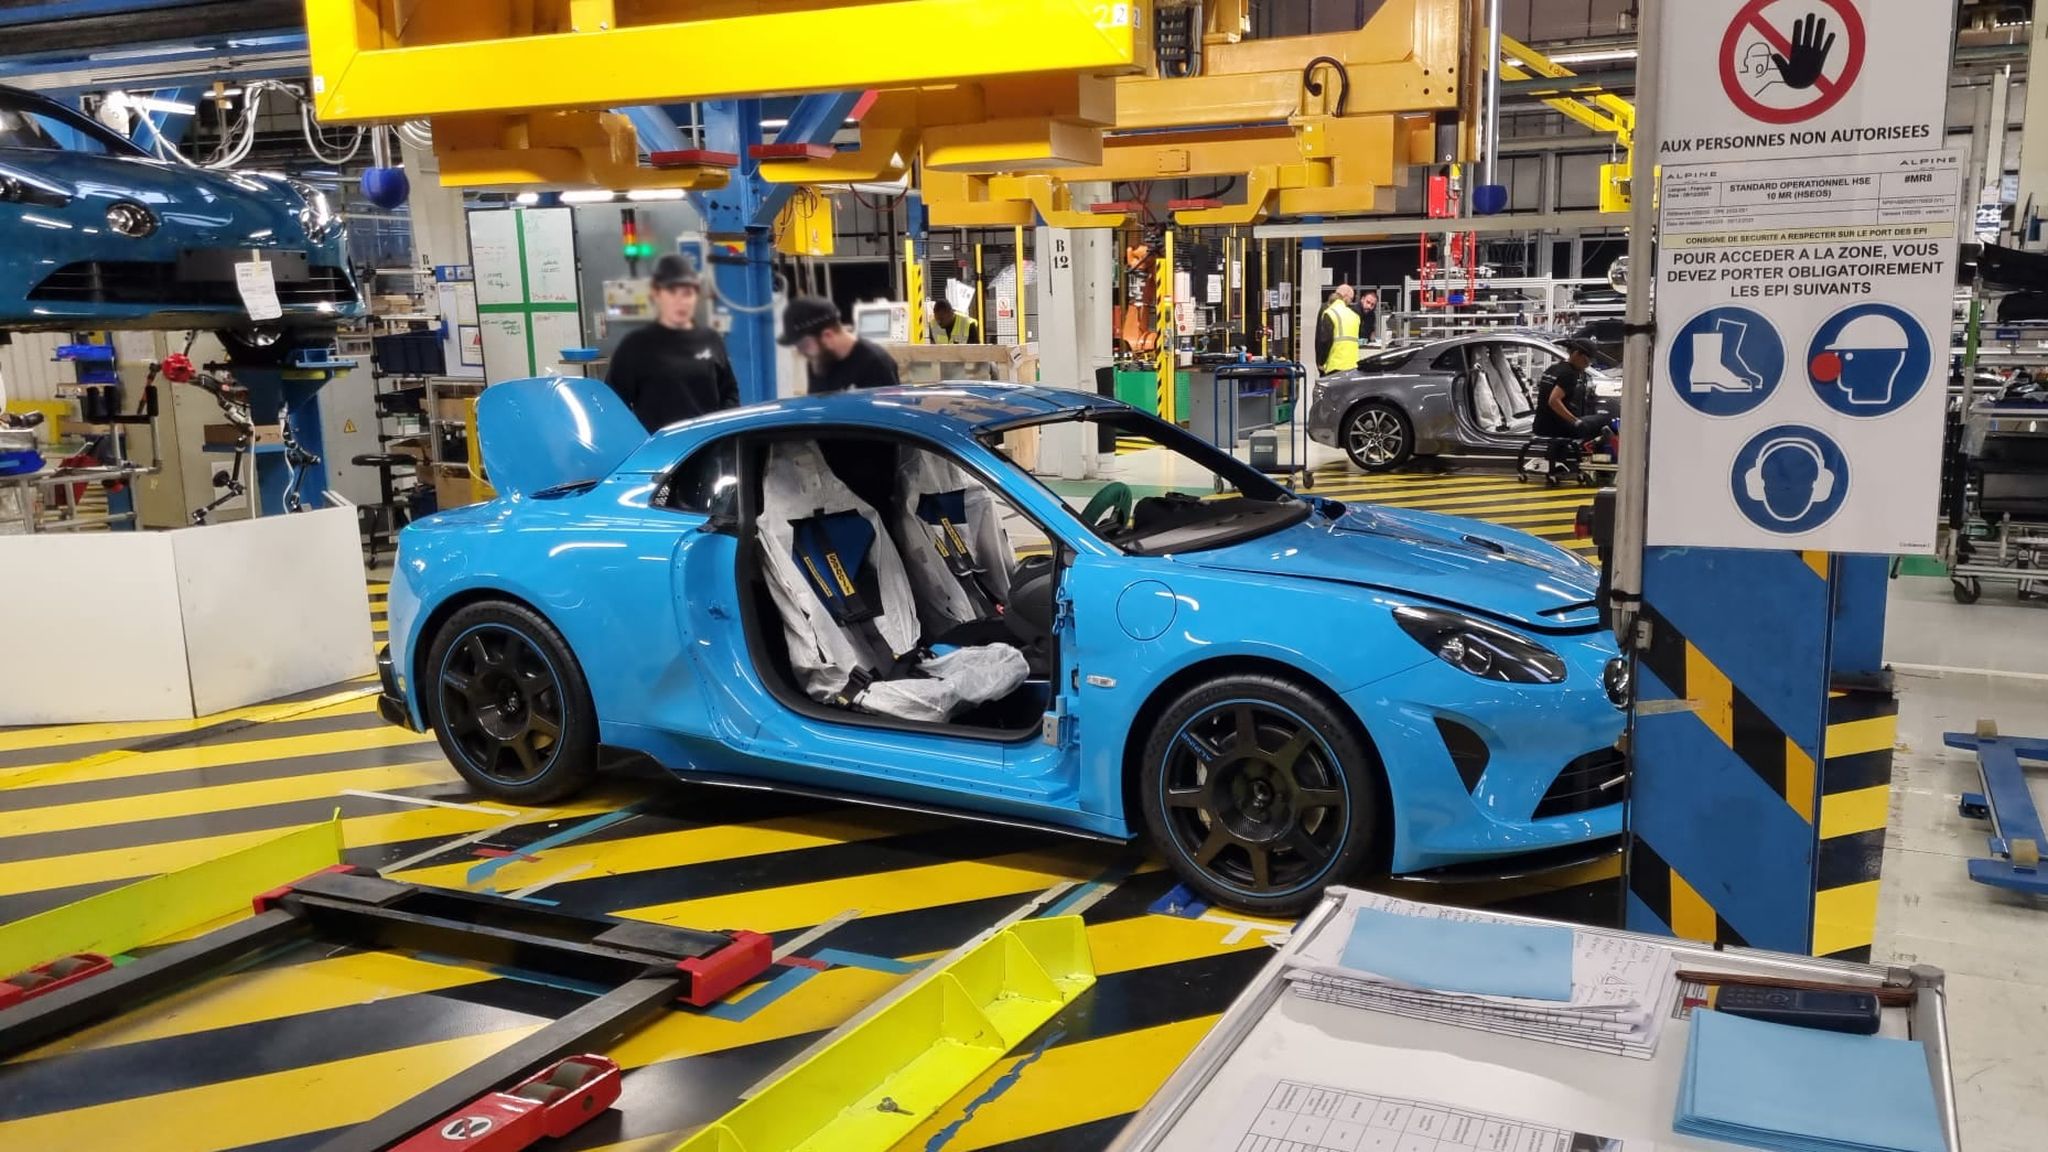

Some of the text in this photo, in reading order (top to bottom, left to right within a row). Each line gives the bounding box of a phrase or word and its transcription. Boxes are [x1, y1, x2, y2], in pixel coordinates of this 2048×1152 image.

[1660, 124, 1930, 153] AUX PERSONNES NON AUTORISEES
[1900, 157, 1957, 166] ALPINE
[1666, 171, 1717, 179] ALPINE
[1729, 177, 1871, 192] STANDARD OPERATIONNEL HSE
[1767, 192, 1776, 200] 10
[1778, 191, 1792, 199] MR
[1686, 236, 1724, 244] CONSIGNE
[1728, 235, 1737, 243] DE
[1788, 231, 1836, 240] RESPECTER
[1857, 229, 1868, 237] LE
[1870, 228, 1892, 236] PORT
[1913, 227, 1928, 235] EPI
[1056, 239, 1065, 252] B
[1673, 243, 1939, 265] POUR ACCEDER A LA ZONE, VOUS
[1054, 255, 1069, 269] 12
[1667, 261, 1944, 282] DEVEZ PORTER OBLIGATOIREMENT
[1731, 281, 1871, 298] LES EPI SUIVANTS
